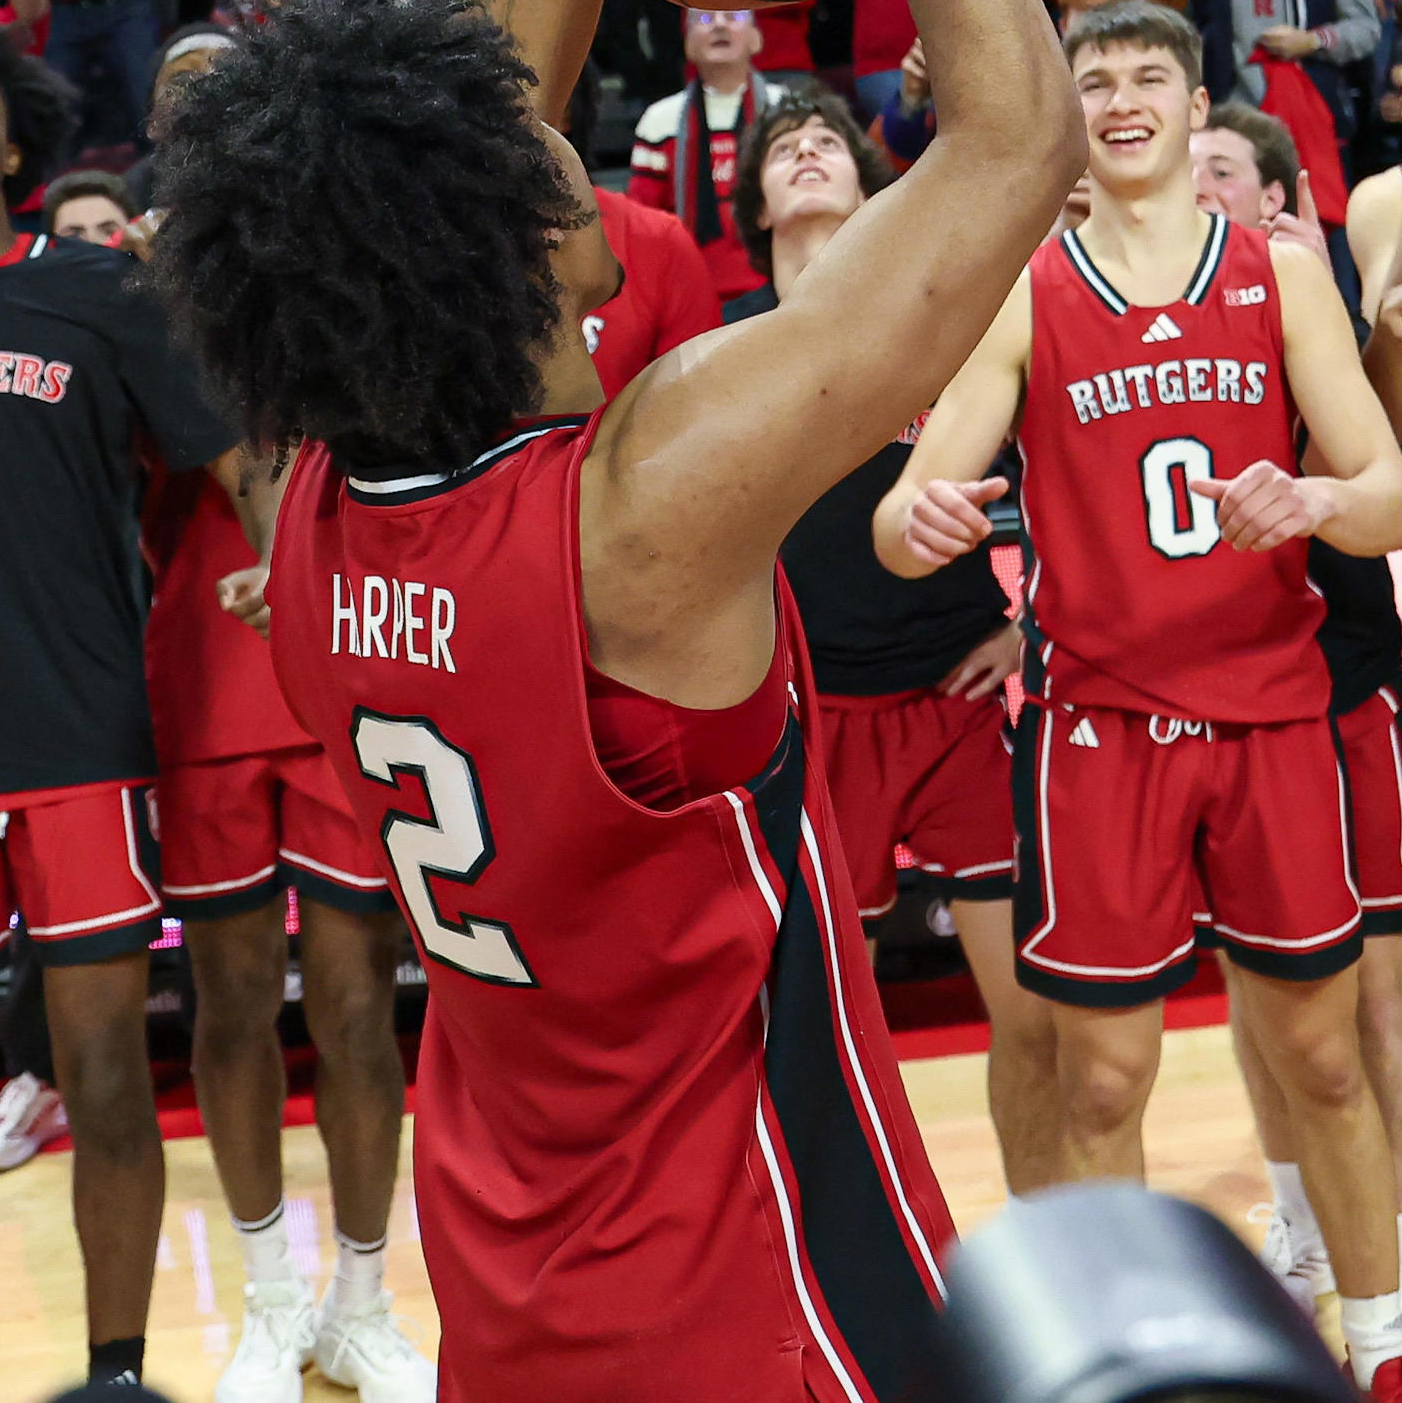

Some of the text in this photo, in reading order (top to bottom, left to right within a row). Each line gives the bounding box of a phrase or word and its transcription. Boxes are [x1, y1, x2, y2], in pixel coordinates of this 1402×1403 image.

[1065, 358, 1268, 425] RUTGERS
[1139, 436, 1223, 561] 0
[350, 705, 542, 989] 2
